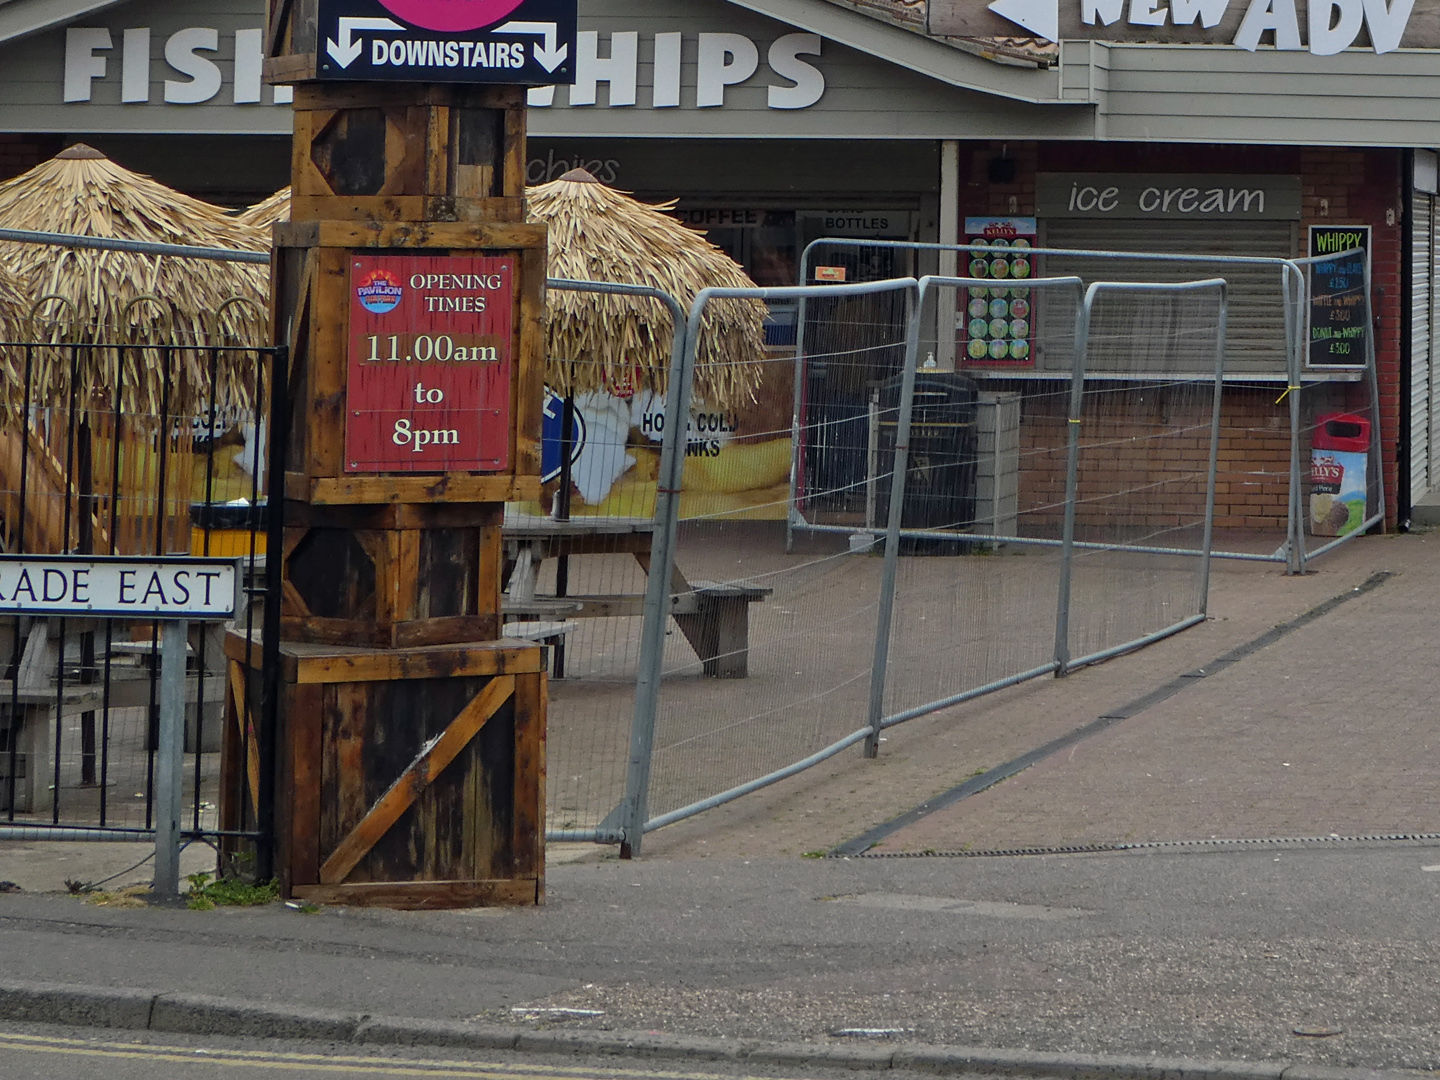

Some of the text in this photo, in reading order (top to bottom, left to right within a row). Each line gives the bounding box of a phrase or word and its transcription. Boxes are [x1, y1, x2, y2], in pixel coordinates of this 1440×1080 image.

[371, 40, 525, 69] DOWNSTAIRS
[527, 30, 825, 109] HIPS
[1068, 181, 1265, 213] ice cream
[825, 217, 889, 229] BOTTLES
[1316, 232, 1362, 252] WHIPPY
[410, 273, 502, 289] OPENING
[425, 296, 486, 312] TIMES
[366, 335, 498, 362] 11.00am
[414, 382, 444, 403] to
[643, 413, 665, 432] HO
[392, 419, 460, 452] 8pm
[0, 568, 221, 606] ADE EAST
